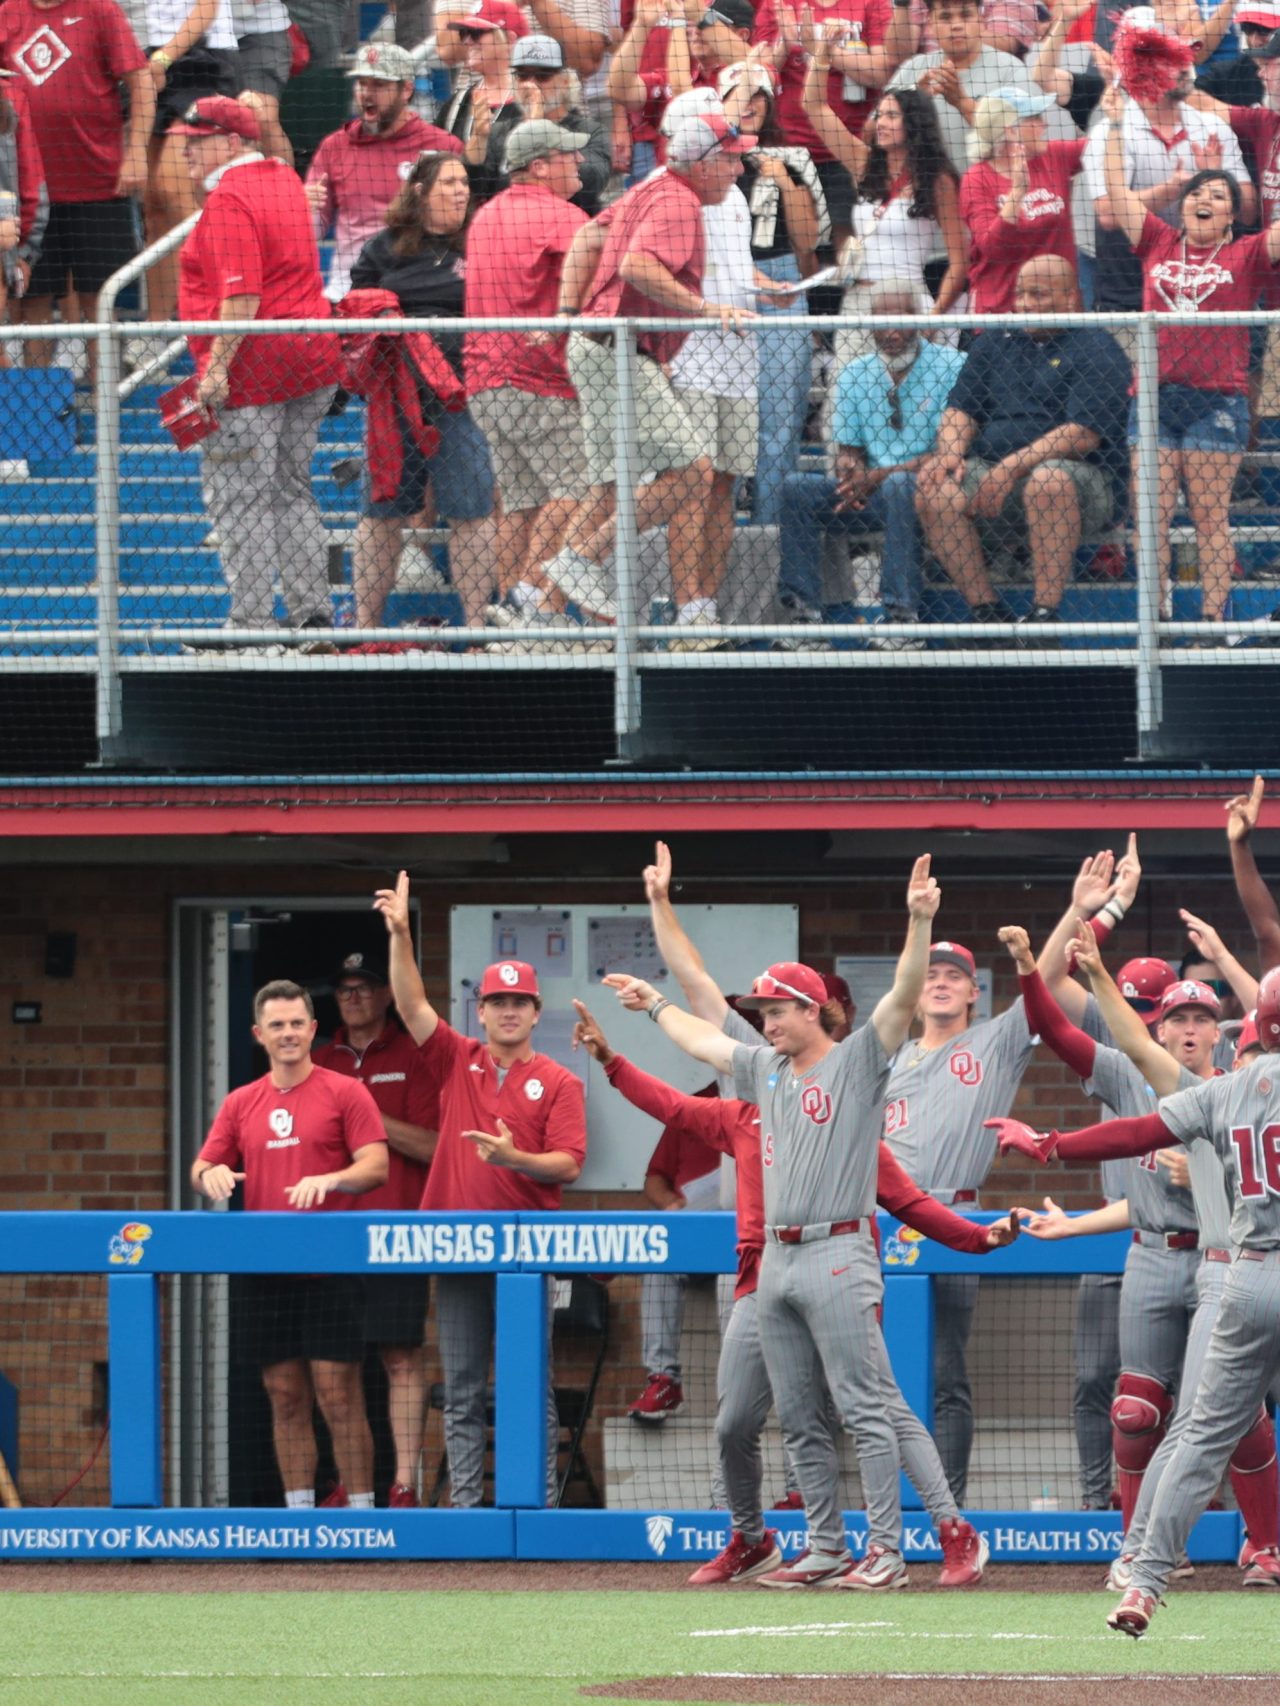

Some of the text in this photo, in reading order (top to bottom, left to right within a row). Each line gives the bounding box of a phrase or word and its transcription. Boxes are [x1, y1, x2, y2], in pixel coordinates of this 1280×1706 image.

[499, 964, 519, 986] OU
[950, 1052, 983, 1086] OU
[523, 1078, 545, 1101] OU
[801, 1085, 833, 1125] OU
[885, 1098, 909, 1135] 21
[268, 1108, 293, 1138] OU
[266, 1137, 301, 1149] BASEBALL
[367, 1224, 669, 1264] KANSAS JAYHAWKS
[0, 1525, 397, 1550] IVERSITY OF KANSAS HEALTH SYSTEM
[677, 1527, 727, 1550] THE
[993, 1527, 1082, 1551] HEALTH
[1086, 1528, 1126, 1551] SYS
